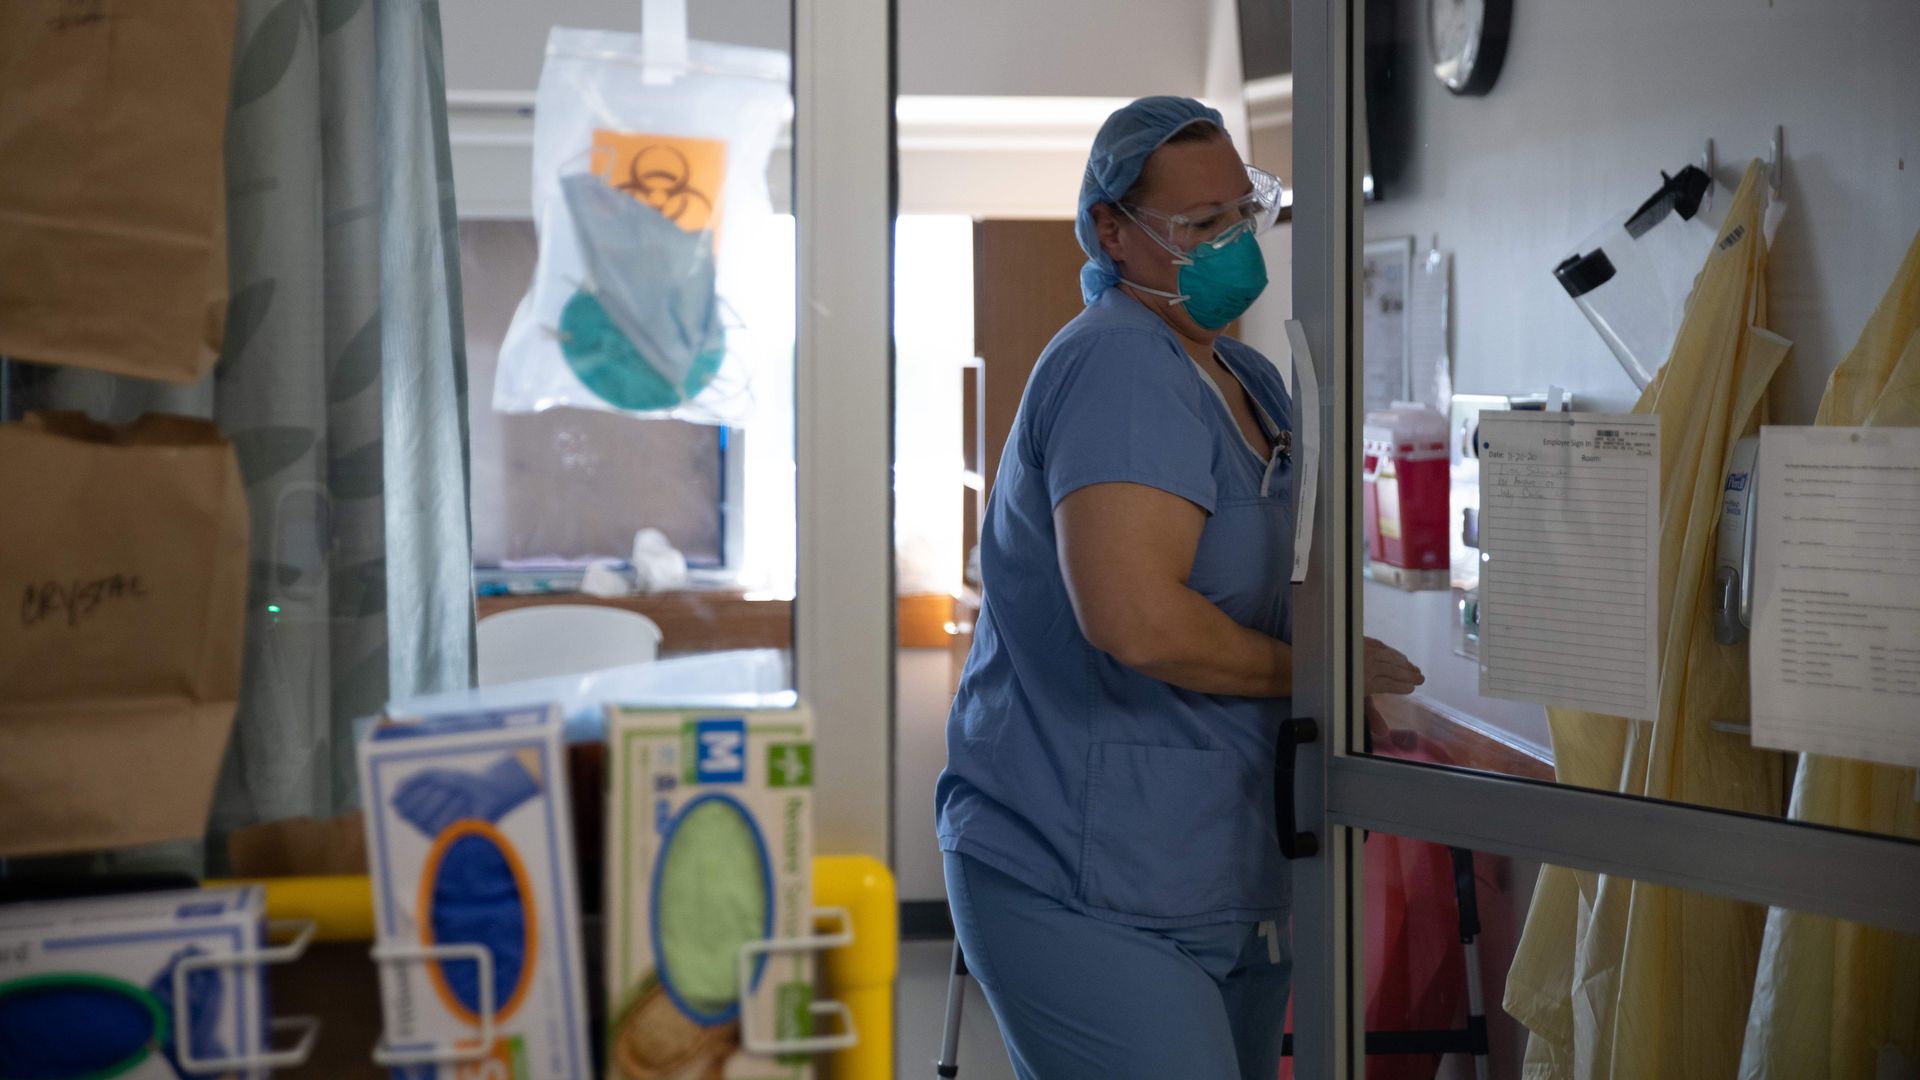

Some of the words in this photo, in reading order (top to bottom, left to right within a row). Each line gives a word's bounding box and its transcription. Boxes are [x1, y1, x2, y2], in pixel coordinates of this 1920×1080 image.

[1543, 438, 1570, 448] Employee
[1570, 439, 1584, 447] Sign
[1489, 451, 1505, 459] Date:
[1581, 454, 1602, 462] Room:
[700, 730, 742, 774] M
